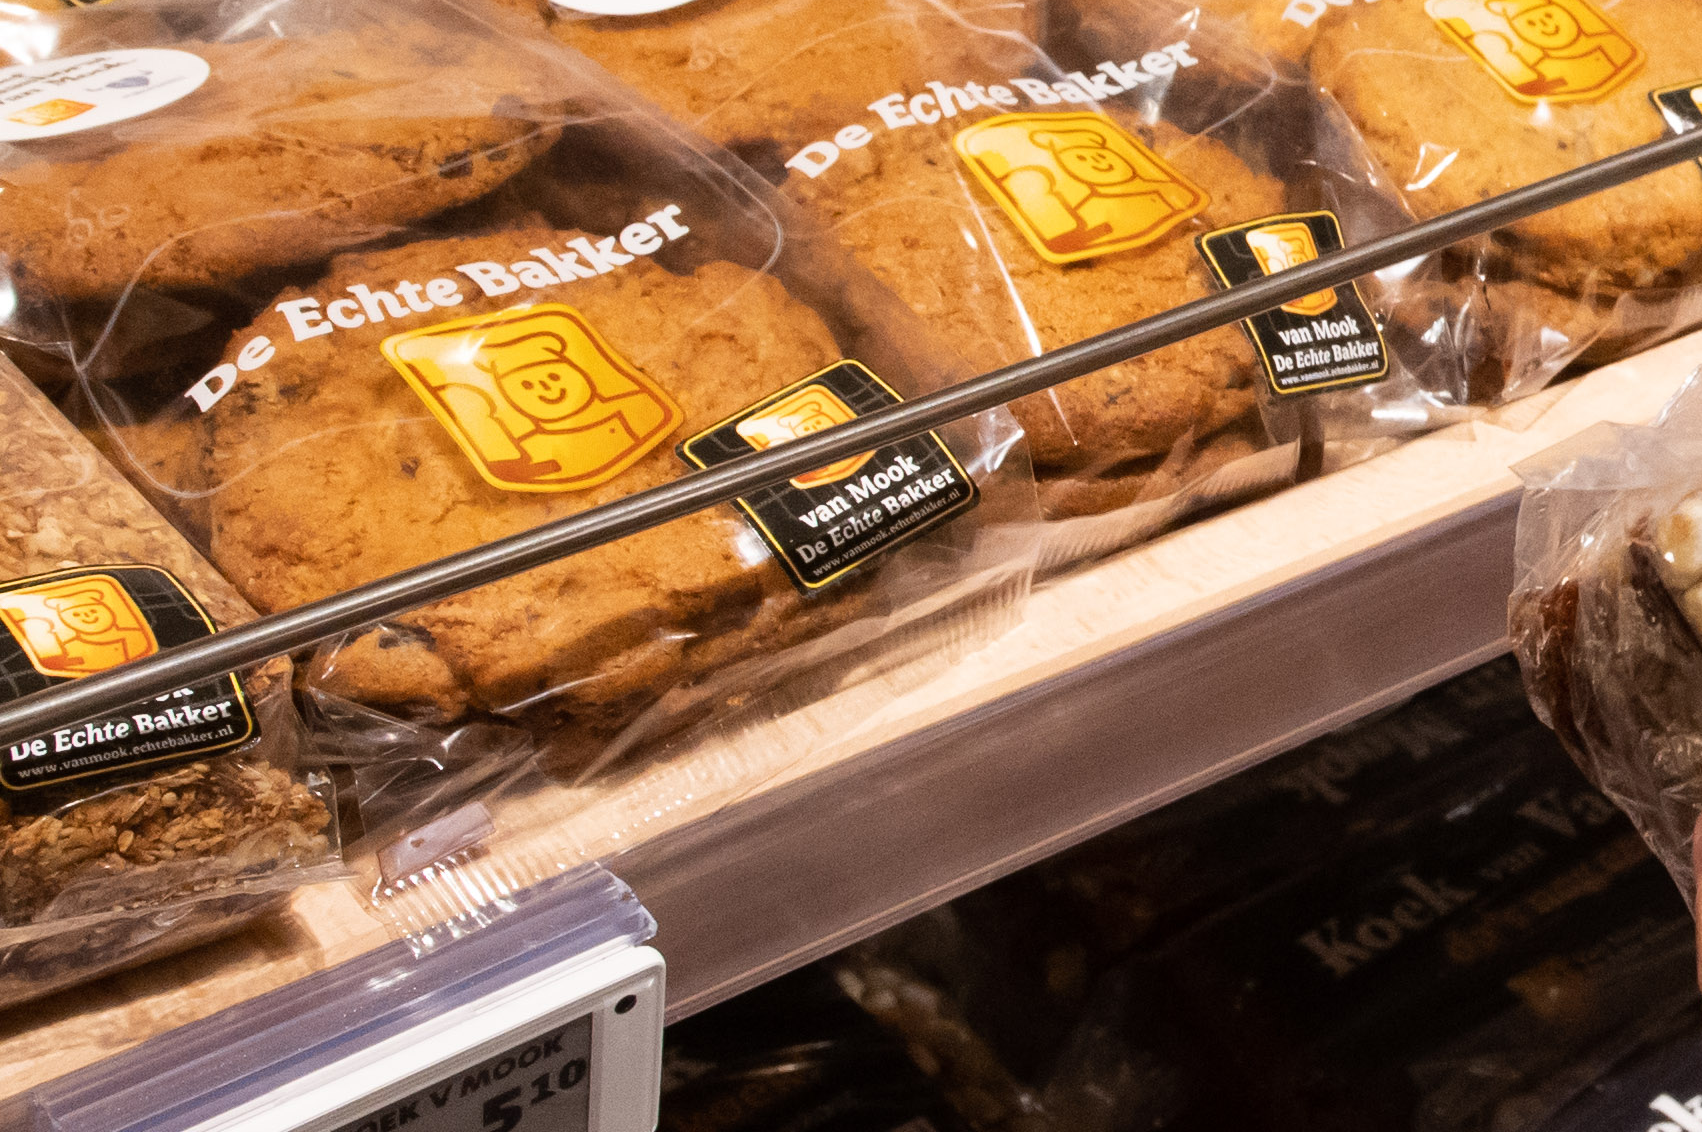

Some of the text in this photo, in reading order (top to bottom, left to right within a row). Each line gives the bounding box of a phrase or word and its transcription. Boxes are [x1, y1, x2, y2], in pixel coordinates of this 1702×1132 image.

[784, 40, 1199, 179] De Echte Bakker
[183, 203, 691, 413] De Echte Bakker
[1278, 314, 1361, 346] van Mook
[1271, 339, 1379, 373] De Echte Bakker
[795, 467, 956, 564] De Echte Bakker
[798, 453, 921, 530] van Mook
[812, 487, 962, 578] www.vanmook.echtebakker.nl
[10, 699, 233, 762] De Echte Bakker
[17, 724, 236, 780] www.vanmook.echtebakker.nl
[459, 1032, 566, 1099] MOOK
